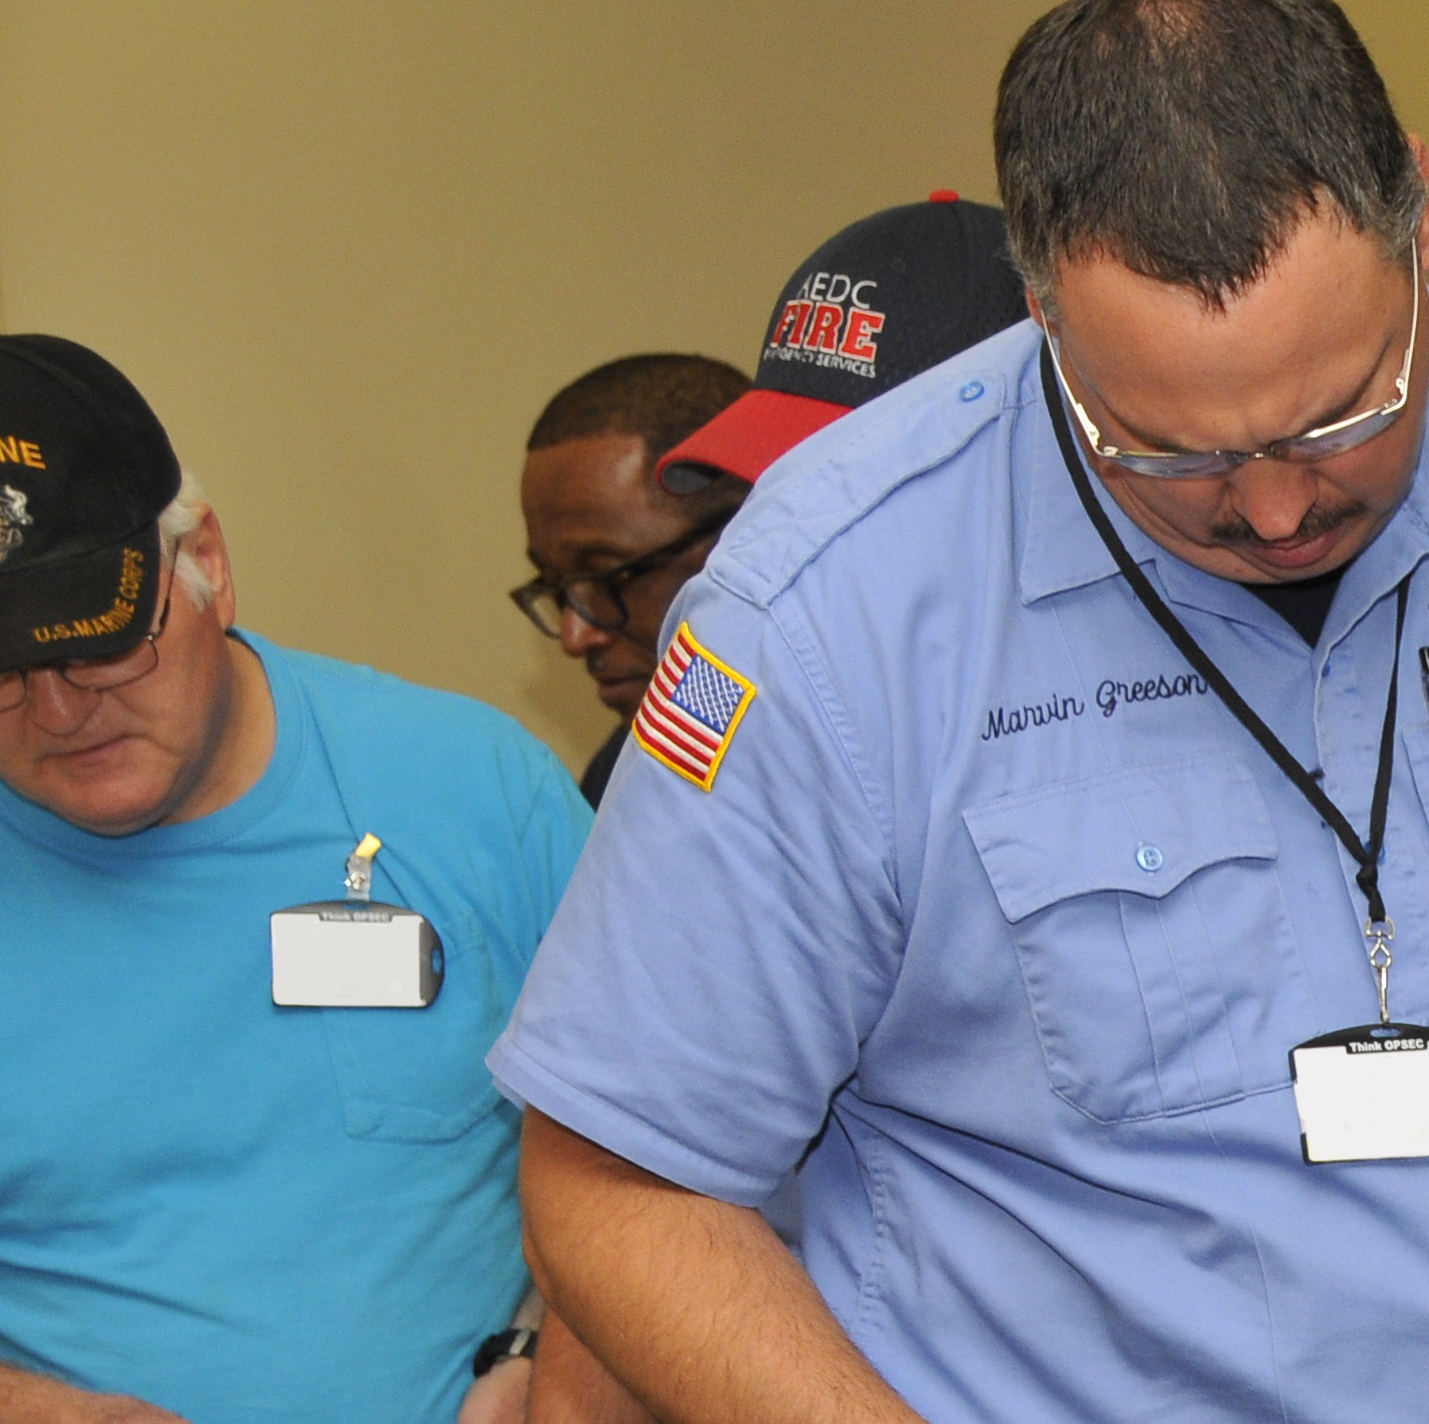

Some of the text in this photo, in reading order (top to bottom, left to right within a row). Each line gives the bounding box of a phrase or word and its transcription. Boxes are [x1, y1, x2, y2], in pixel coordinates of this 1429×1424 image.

[796, 272, 878, 310] AEDC
[770, 299, 886, 364] FIRE
[815, 352, 877, 379] SERVICES
[119, 547, 145, 601] CORPS
[981, 672, 1210, 741] Marvin Greeson
[1348, 1037, 1425, 1053] Think OPSEC
